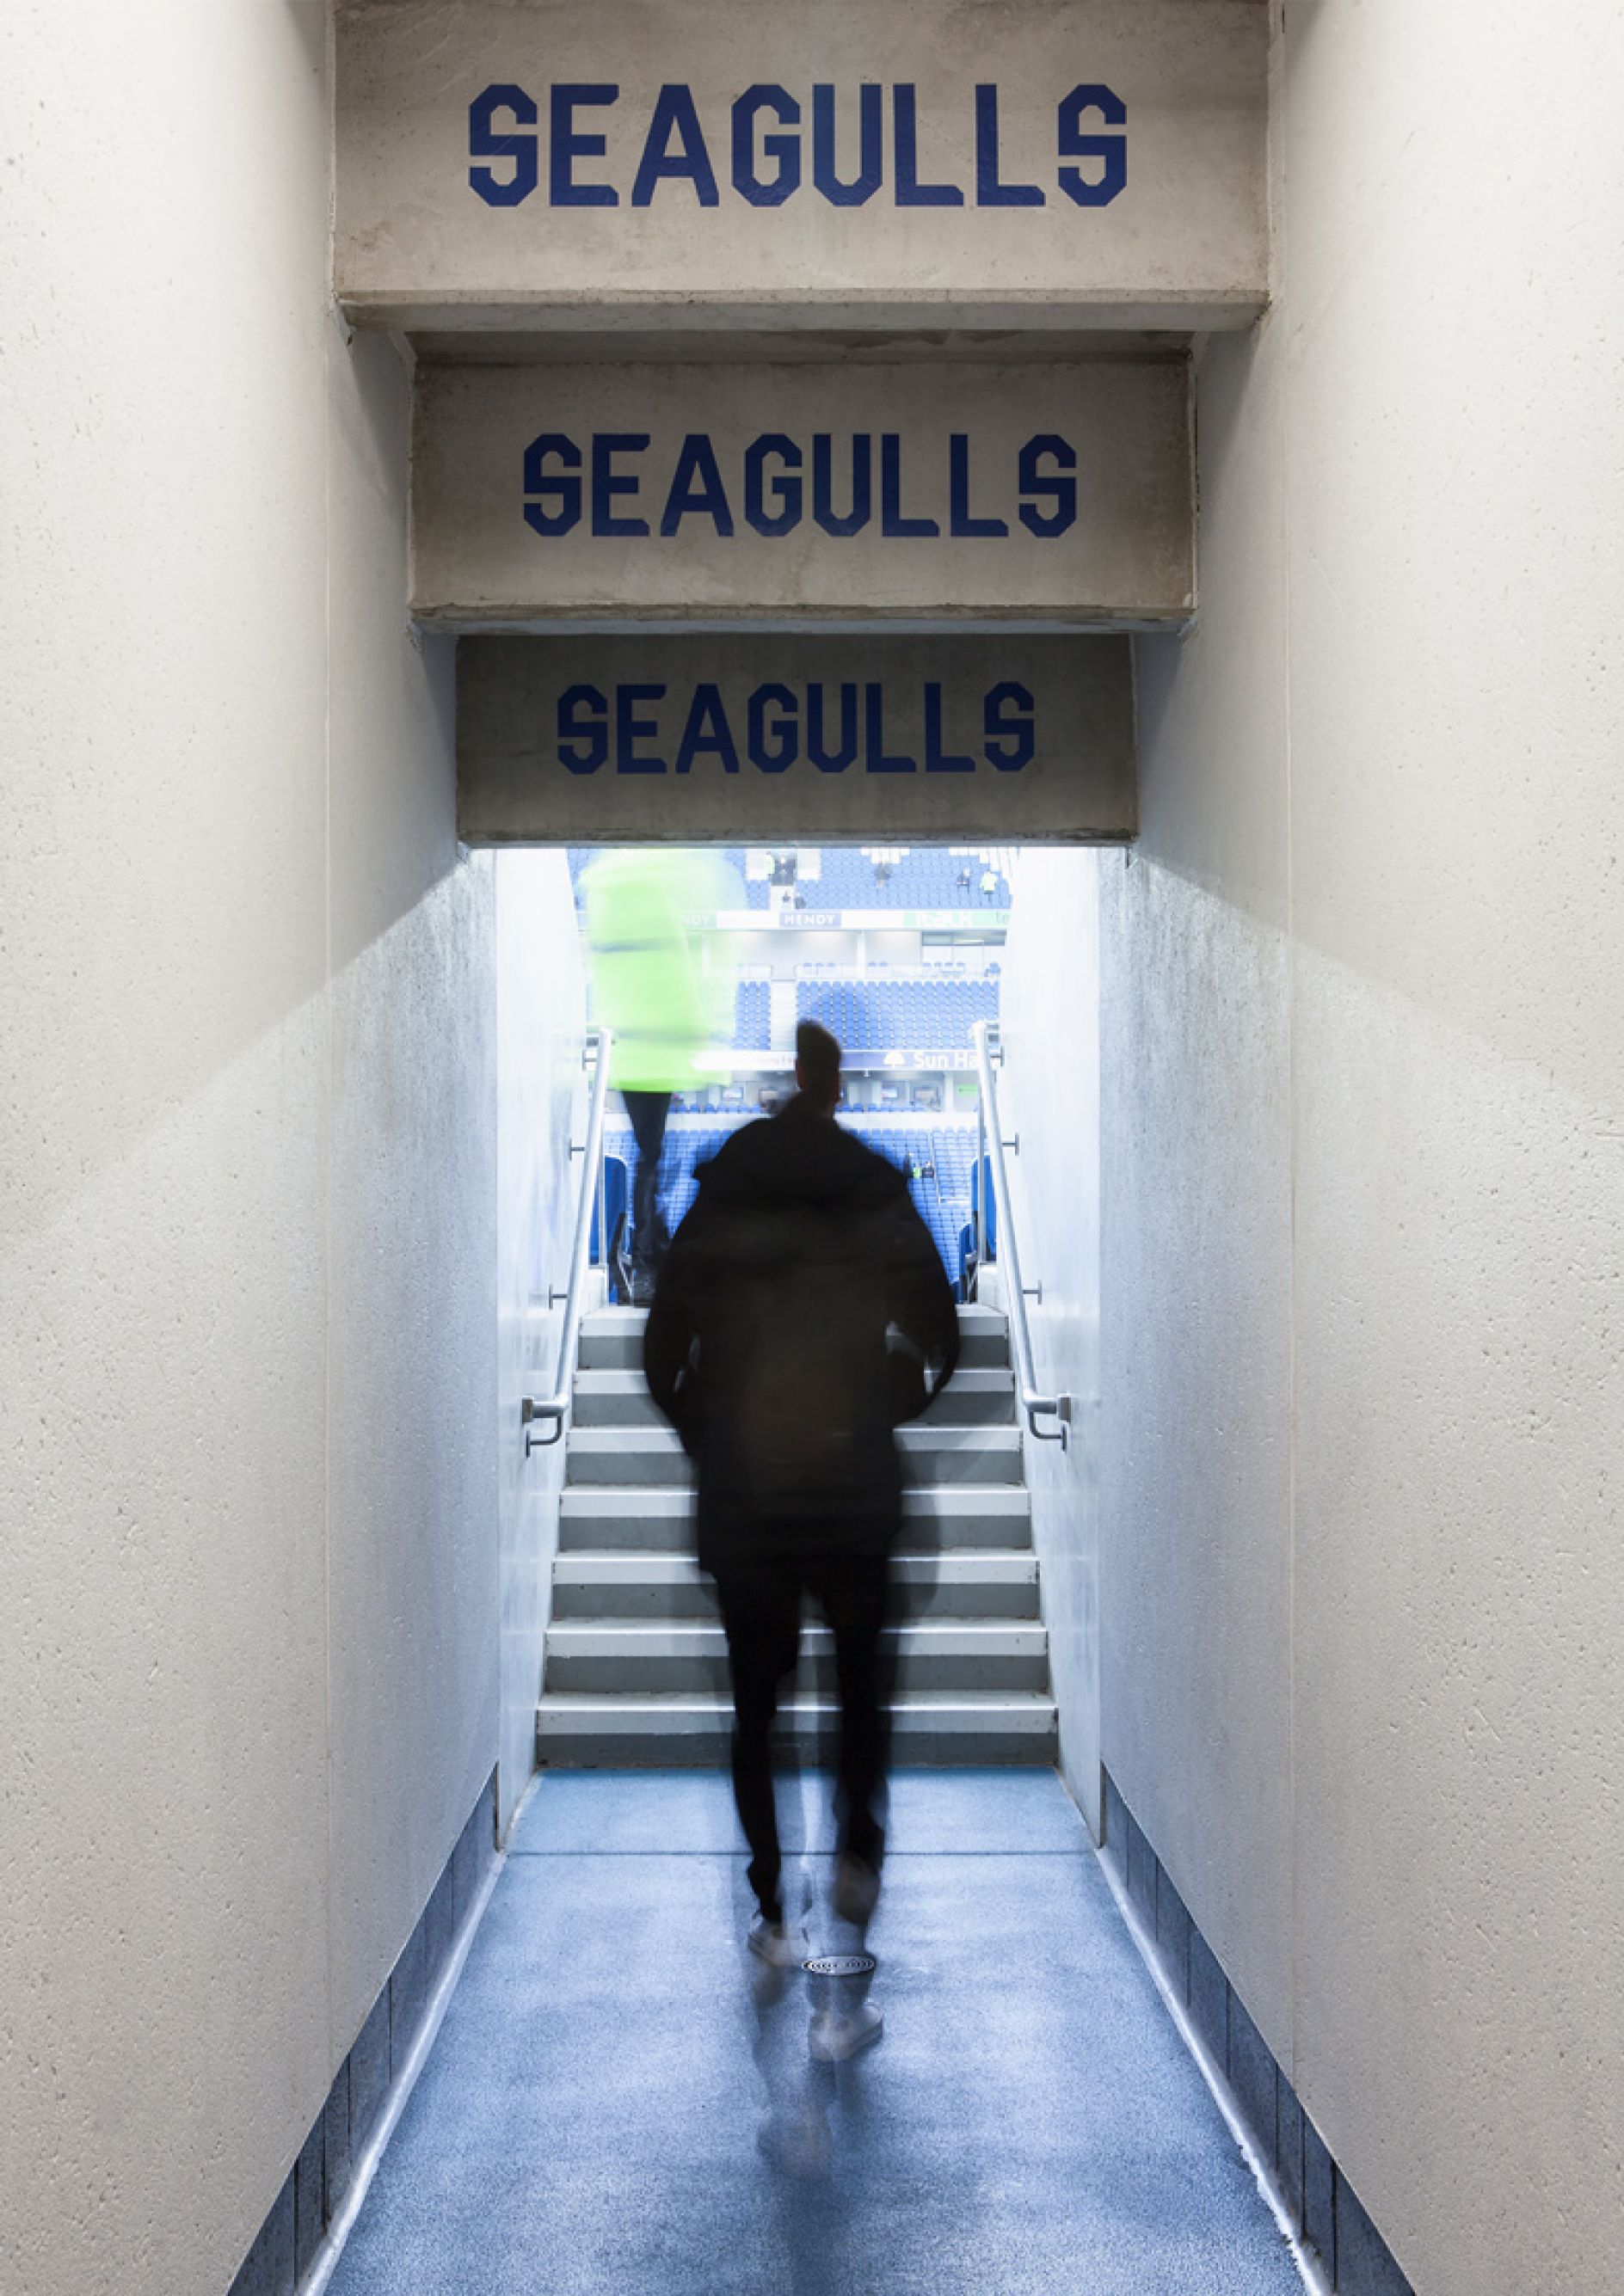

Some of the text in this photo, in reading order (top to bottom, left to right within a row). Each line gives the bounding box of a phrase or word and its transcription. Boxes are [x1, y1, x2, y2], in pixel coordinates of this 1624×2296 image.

[468, 83, 1128, 207] SEAGULLS
[522, 433, 1077, 538] SEAGULLS
[557, 681, 1035, 775] SEAGULLS
[784, 913, 836, 926] HENDY
[913, 1052, 950, 1068] Sun
